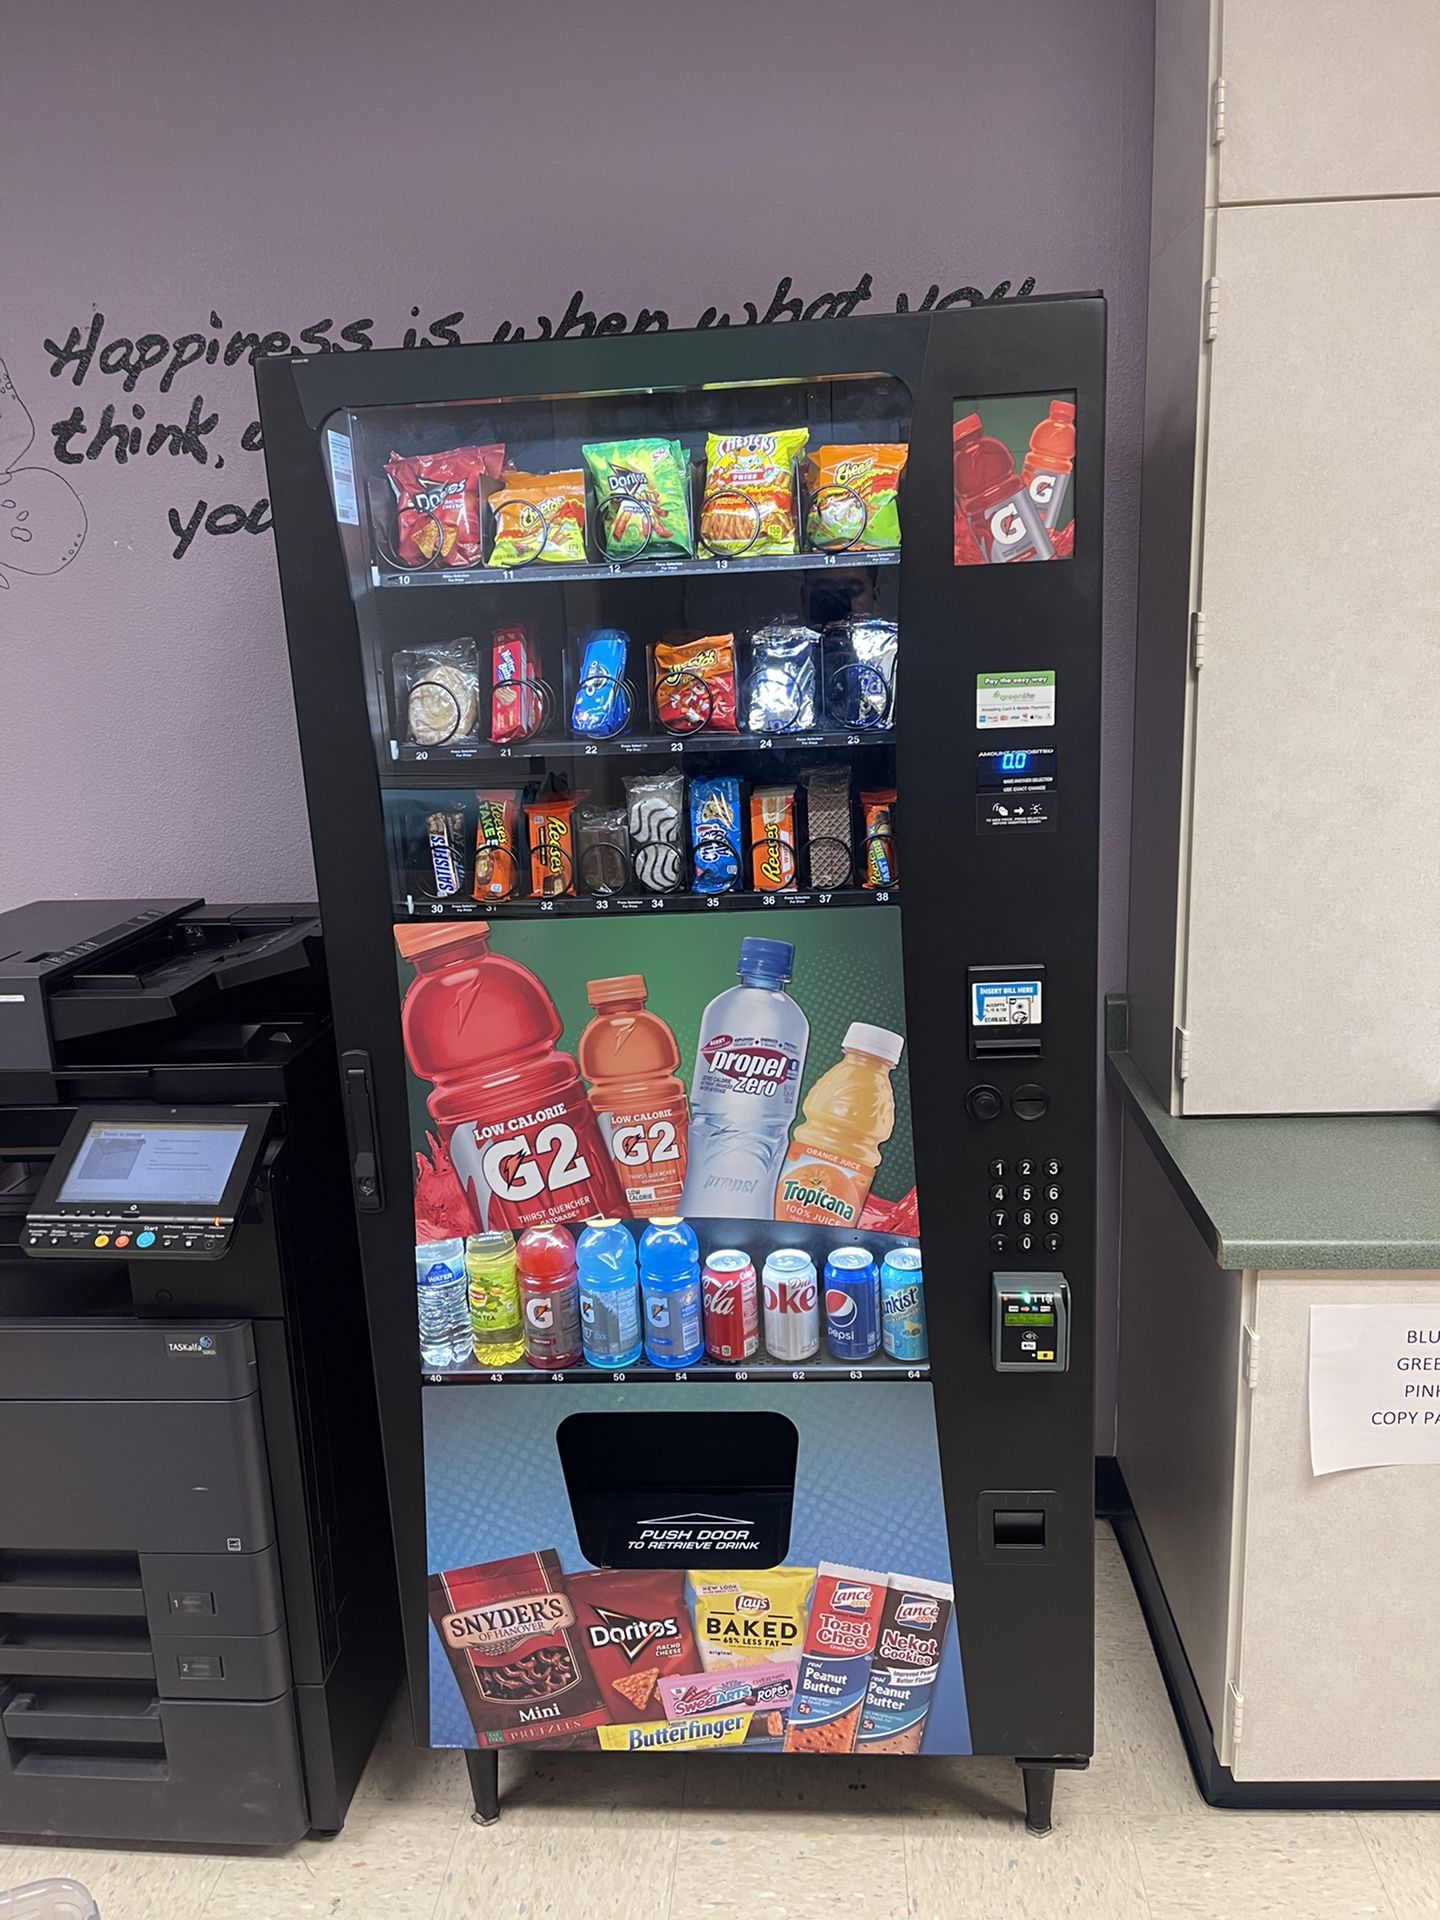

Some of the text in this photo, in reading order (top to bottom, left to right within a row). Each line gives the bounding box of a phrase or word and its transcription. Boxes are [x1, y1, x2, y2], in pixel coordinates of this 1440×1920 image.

[43, 311, 374, 393] Happiness
[404, 306, 465, 348] is
[1029, 475, 1056, 503] G
[991, 502, 1027, 545] G
[716, 561, 728, 569] 13
[823, 556, 836, 565] 14
[502, 571, 514, 580] 11
[608, 565, 621, 574] 12
[398, 576, 410, 585] 10
[671, 742, 683, 752] 23
[760, 740, 772, 748] 24
[848, 736, 860, 744] 25
[416, 752, 428, 760] 20
[500, 749, 511, 757] 21
[585, 746, 597, 754] 22
[479, 802, 496, 838] TAKE
[596, 900, 608, 909] 33
[652, 899, 664, 908] 34
[707, 898, 719, 907] 35
[763, 896, 775, 905] 36
[819, 895, 832, 903] 37
[876, 893, 889, 902] 38
[431, 904, 444, 914] 30
[541, 901, 553, 911] 32
[708, 1050, 788, 1078] propel
[732, 1076, 778, 1097] zero
[474, 1103, 567, 1141] LOW CALORIE
[611, 1109, 672, 1124] LOW CALORIE
[612, 1120, 681, 1167] G2
[482, 1122, 592, 1202] G2
[806, 1147, 861, 1171] ORANGE JUICE
[996, 1162, 1058, 1176] 1 2 3
[783, 1179, 855, 1221] Tropicana
[995, 1188, 1058, 1200] 4 5 6
[518, 1195, 591, 1224] THIRST QUENCHER
[785, 1204, 810, 1218] 100%
[812, 1215, 841, 1226] JUICE
[996, 1213, 1058, 1226] 7 8 9
[1023, 1238, 1031, 1249] 0
[763, 1282, 816, 1314] oke
[526, 1298, 553, 1329] G
[646, 1297, 670, 1328] G
[828, 1326, 854, 1340] pepsi
[430, 1374, 442, 1382] 40
[490, 1373, 503, 1382] 43
[552, 1373, 564, 1382] 45
[613, 1373, 625, 1382] 50
[675, 1372, 687, 1381] 54
[735, 1372, 747, 1380] 60
[792, 1372, 805, 1380] 62
[850, 1371, 862, 1379] 63
[908, 1370, 920, 1379] 64
[1404, 1384, 1440, 1398] PIN
[1371, 1412, 1418, 1425] COPY
[640, 1530, 750, 1540] PUSH DOOR
[628, 1541, 645, 1549] TO
[715, 1542, 760, 1550] DRINK
[738, 1596, 768, 1610] Lay's
[832, 1590, 873, 1604] Lance
[450, 1598, 564, 1638] SNYDER'S
[896, 1605, 939, 1620] Lance
[479, 1622, 546, 1641] OF HANOVER
[590, 1618, 678, 1647] Doritos
[707, 1617, 797, 1639] BAKED
[820, 1614, 871, 1637] Toast
[817, 1629, 867, 1650] Chee
[882, 1629, 937, 1655] Nekot
[656, 1648, 681, 1656] CHEESE
[880, 1647, 932, 1666] Cookies
[805, 1668, 848, 1685] Peanut
[803, 1679, 842, 1696] Butter
[868, 1682, 911, 1700] Peanut
[866, 1693, 905, 1710] Butter
[519, 1703, 561, 1722] Mini
[510, 1721, 582, 1740] PRETZELS
[629, 1717, 744, 1750] Butterfinger
